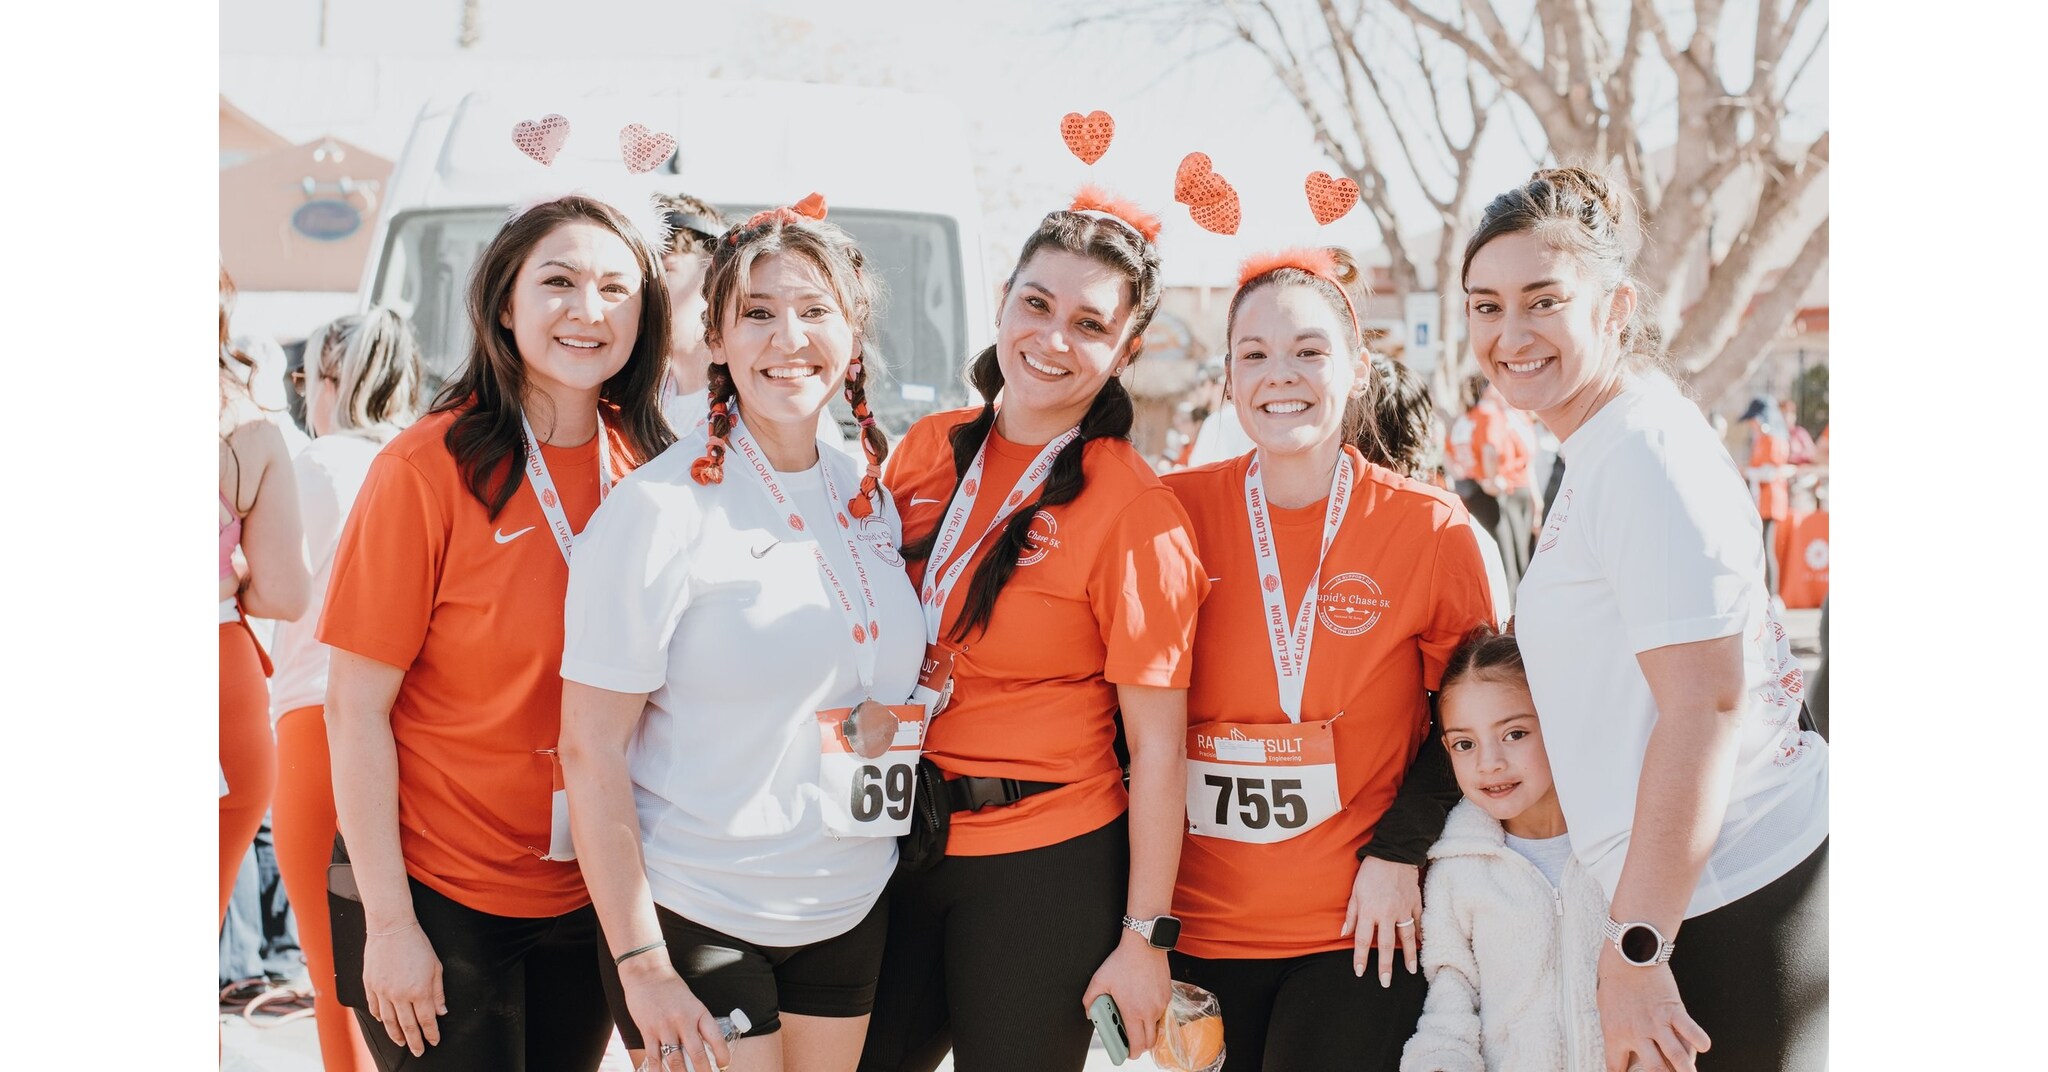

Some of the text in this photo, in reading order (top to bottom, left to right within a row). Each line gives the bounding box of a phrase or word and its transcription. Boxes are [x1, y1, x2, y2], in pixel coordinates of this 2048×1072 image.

[738, 436, 787, 504] LIVE.LOVE.RUN
[1329, 459, 1350, 527] LIVE.LOVE.RUN
[1027, 530, 1061, 549] Chase 5K
[1250, 487, 1271, 558] LIVE.LOVE.RUN
[847, 540, 875, 608] LIVE.LOVE.RUN
[1317, 592, 1391, 609] upid's Chase 5K
[1271, 604, 1293, 677] LIVE.LOVE.RUN
[1268, 755, 1302, 763] Engineering
[1204, 774, 1308, 829] 755
